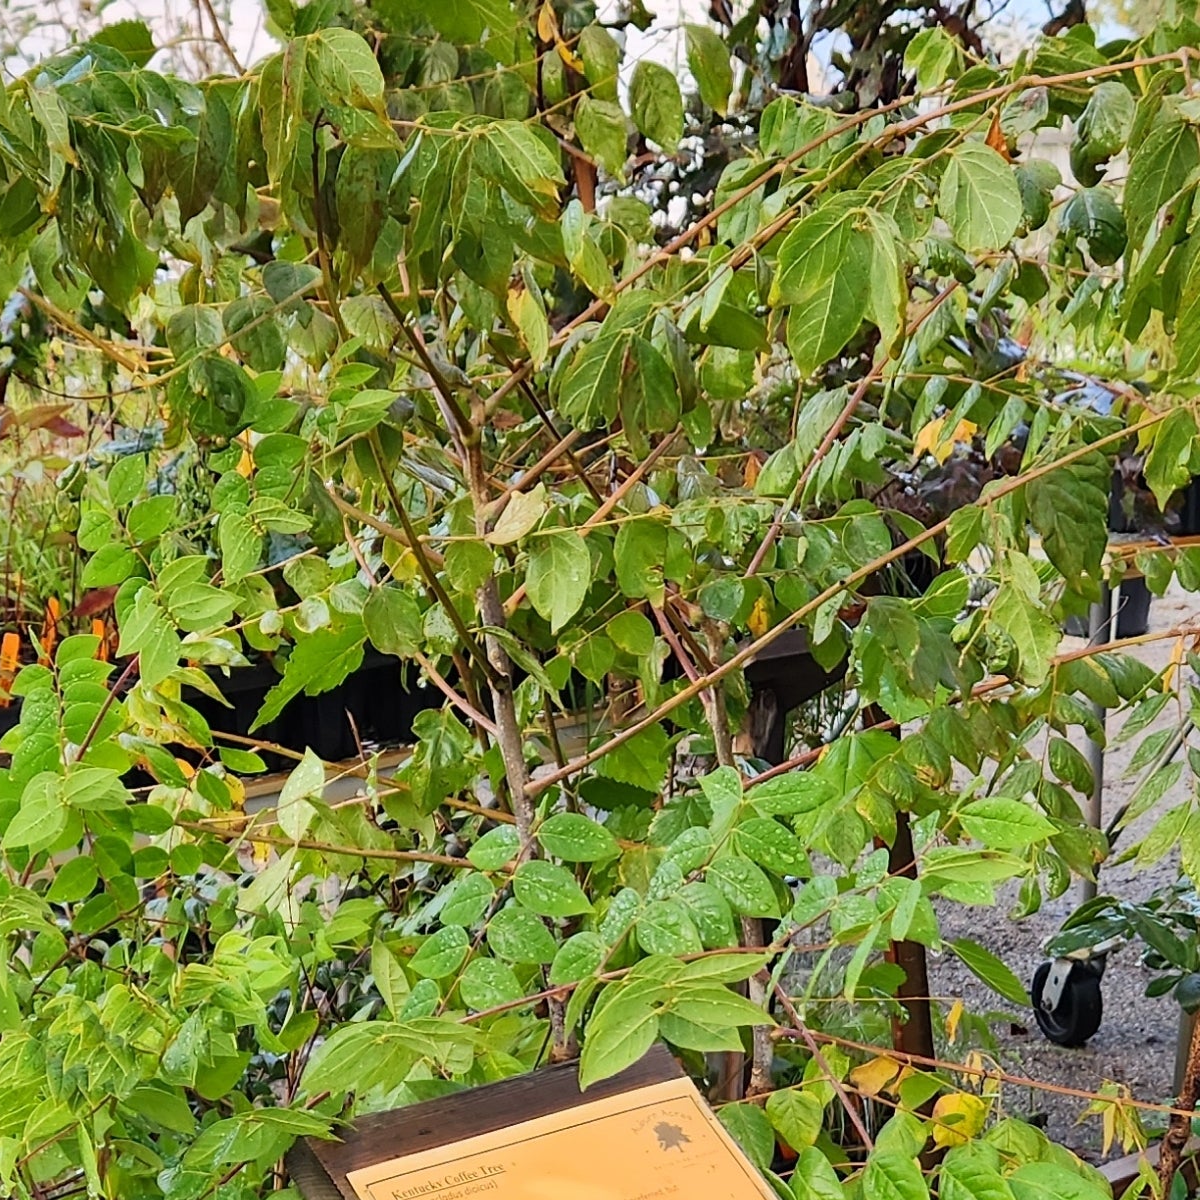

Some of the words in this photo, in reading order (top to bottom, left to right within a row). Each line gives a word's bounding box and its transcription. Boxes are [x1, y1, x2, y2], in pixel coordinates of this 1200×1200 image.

[391, 1178, 443, 1200] Kentucky
[443, 1168, 480, 1186] Coffee
[478, 1161, 506, 1176] Tree
